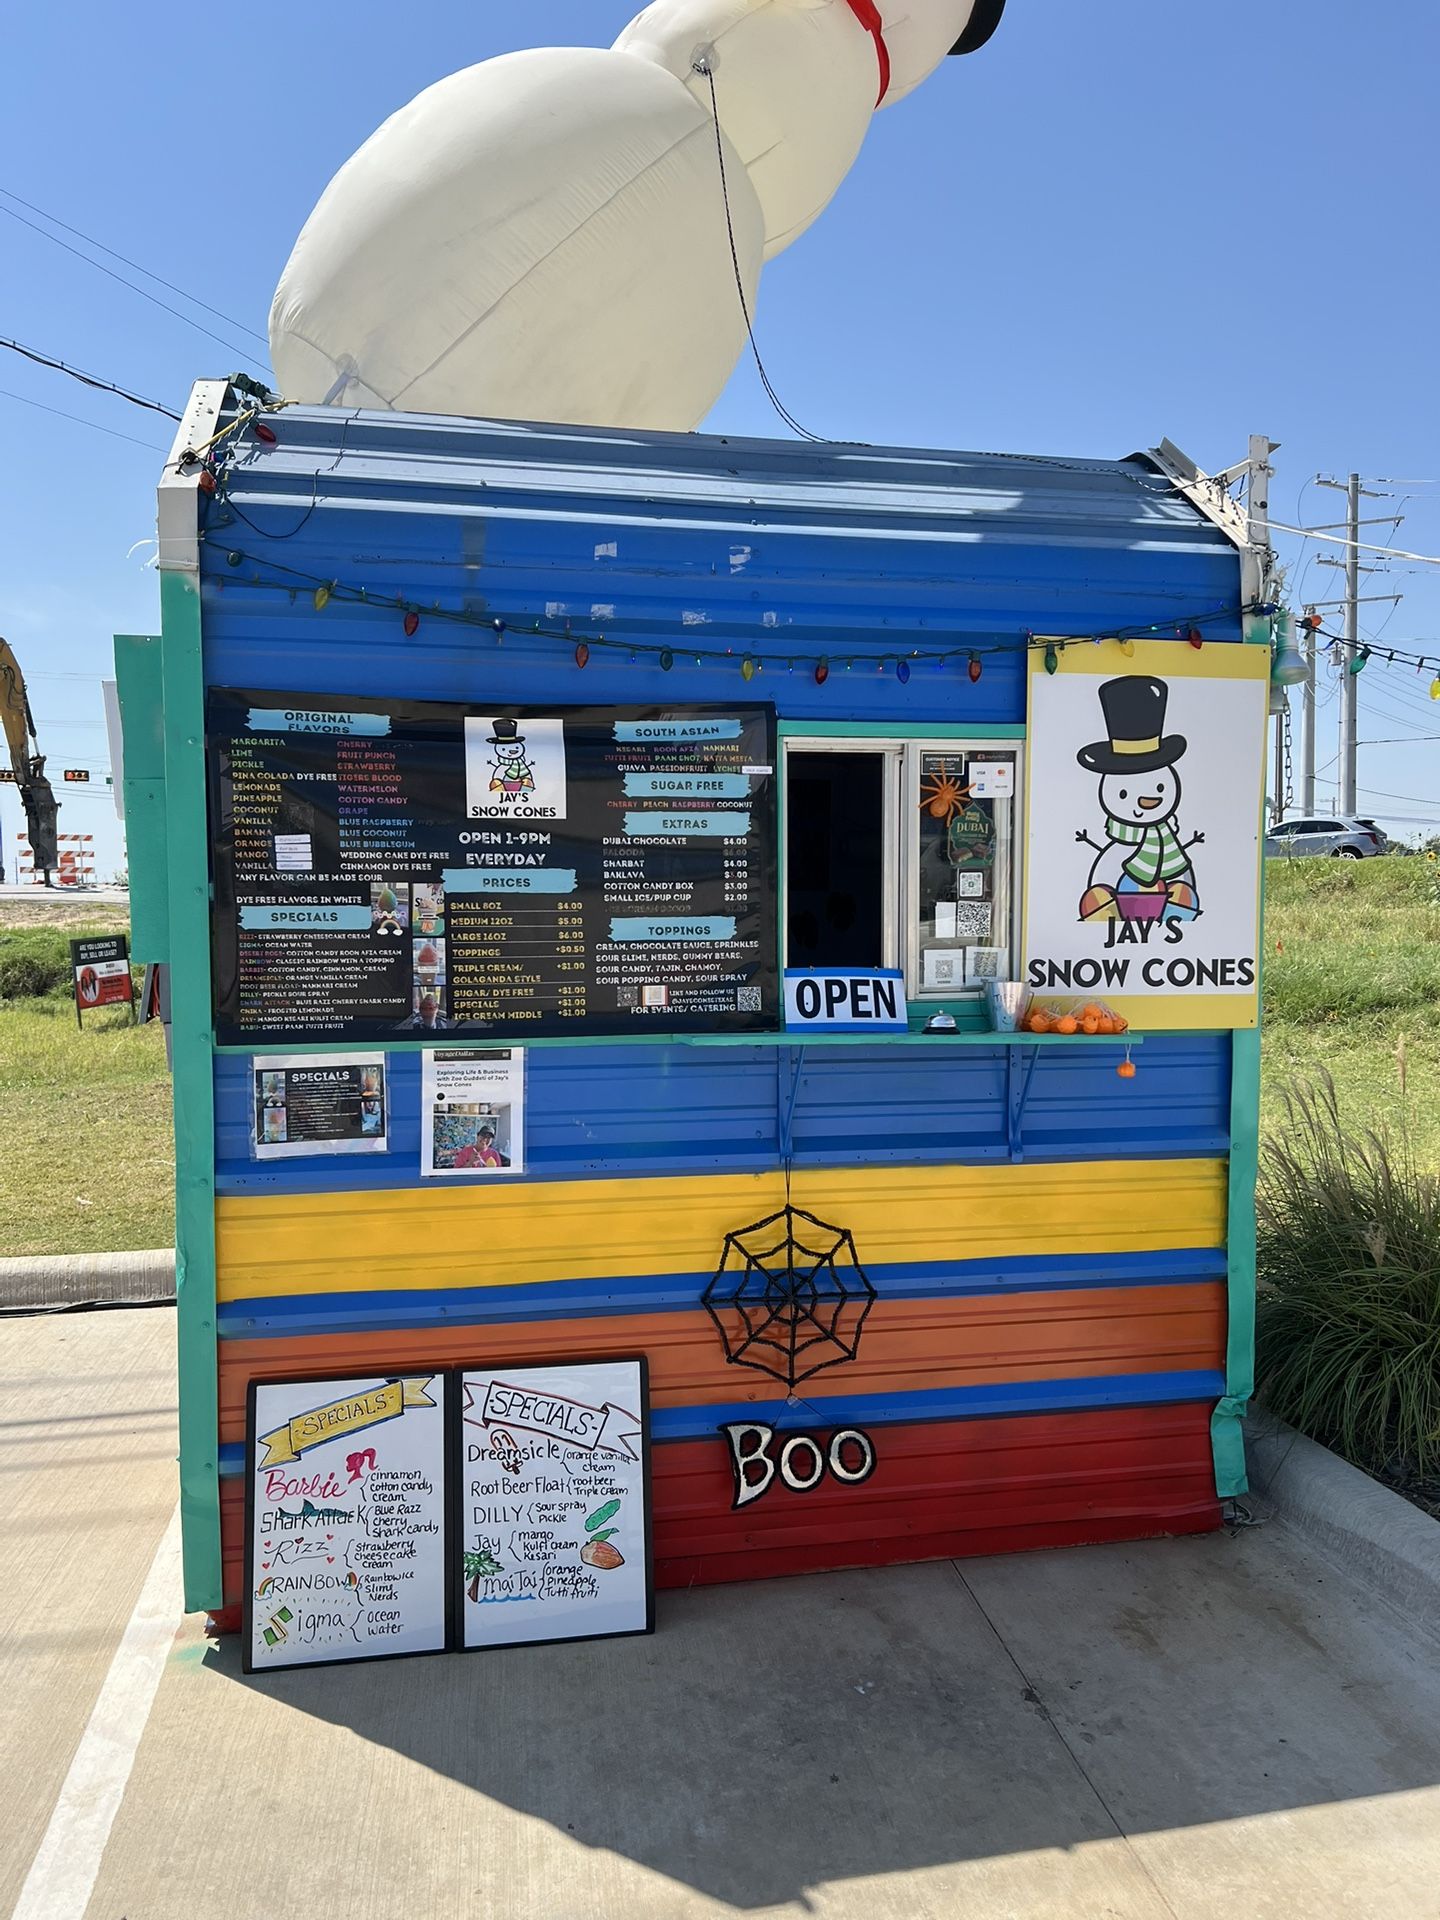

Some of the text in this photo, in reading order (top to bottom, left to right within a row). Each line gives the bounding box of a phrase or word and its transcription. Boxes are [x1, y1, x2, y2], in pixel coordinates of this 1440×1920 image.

[284, 712, 354, 724] ORIGINAL
[288, 724, 350, 733] FLAVORS
[636, 727, 719, 737] SOUTH ASIAN
[231, 738, 286, 746] MARGARITA
[651, 781, 723, 790] SUGAR FREE
[499, 793, 529, 803] JAY'S
[472, 806, 556, 817] SNOW CONES
[662, 820, 708, 828] EXTRAS
[957, 823, 989, 834] DUBAI
[459, 832, 551, 845] OPEN 1-9PM
[466, 853, 546, 865] EVERYDAY
[603, 860, 644, 868] SHARBAT
[724, 860, 747, 868] $4.00
[483, 878, 531, 888] PRICES
[271, 912, 338, 922] SPECIALS
[648, 926, 711, 935] TOPPINGS
[1104, 916, 1183, 949] JAY'S
[453, 964, 485, 972] TRIPLE
[1028, 958, 1254, 988] SNOW CONES
[512, 988, 534, 996] FREE
[796, 979, 897, 1019] OPEN
[508, 1011, 542, 1019] MIDDLE
[292, 1071, 350, 1082] SPECIALS
[468, 1439, 560, 1462] Dreamsicle
[264, 1469, 347, 1501] Barbie
[471, 1477, 565, 1497] Root Beer Float
[397, 1504, 421, 1515] Razz
[473, 1505, 523, 1525] DILLY
[472, 1534, 500, 1554] Jay
[264, 1540, 329, 1567] Rizz
